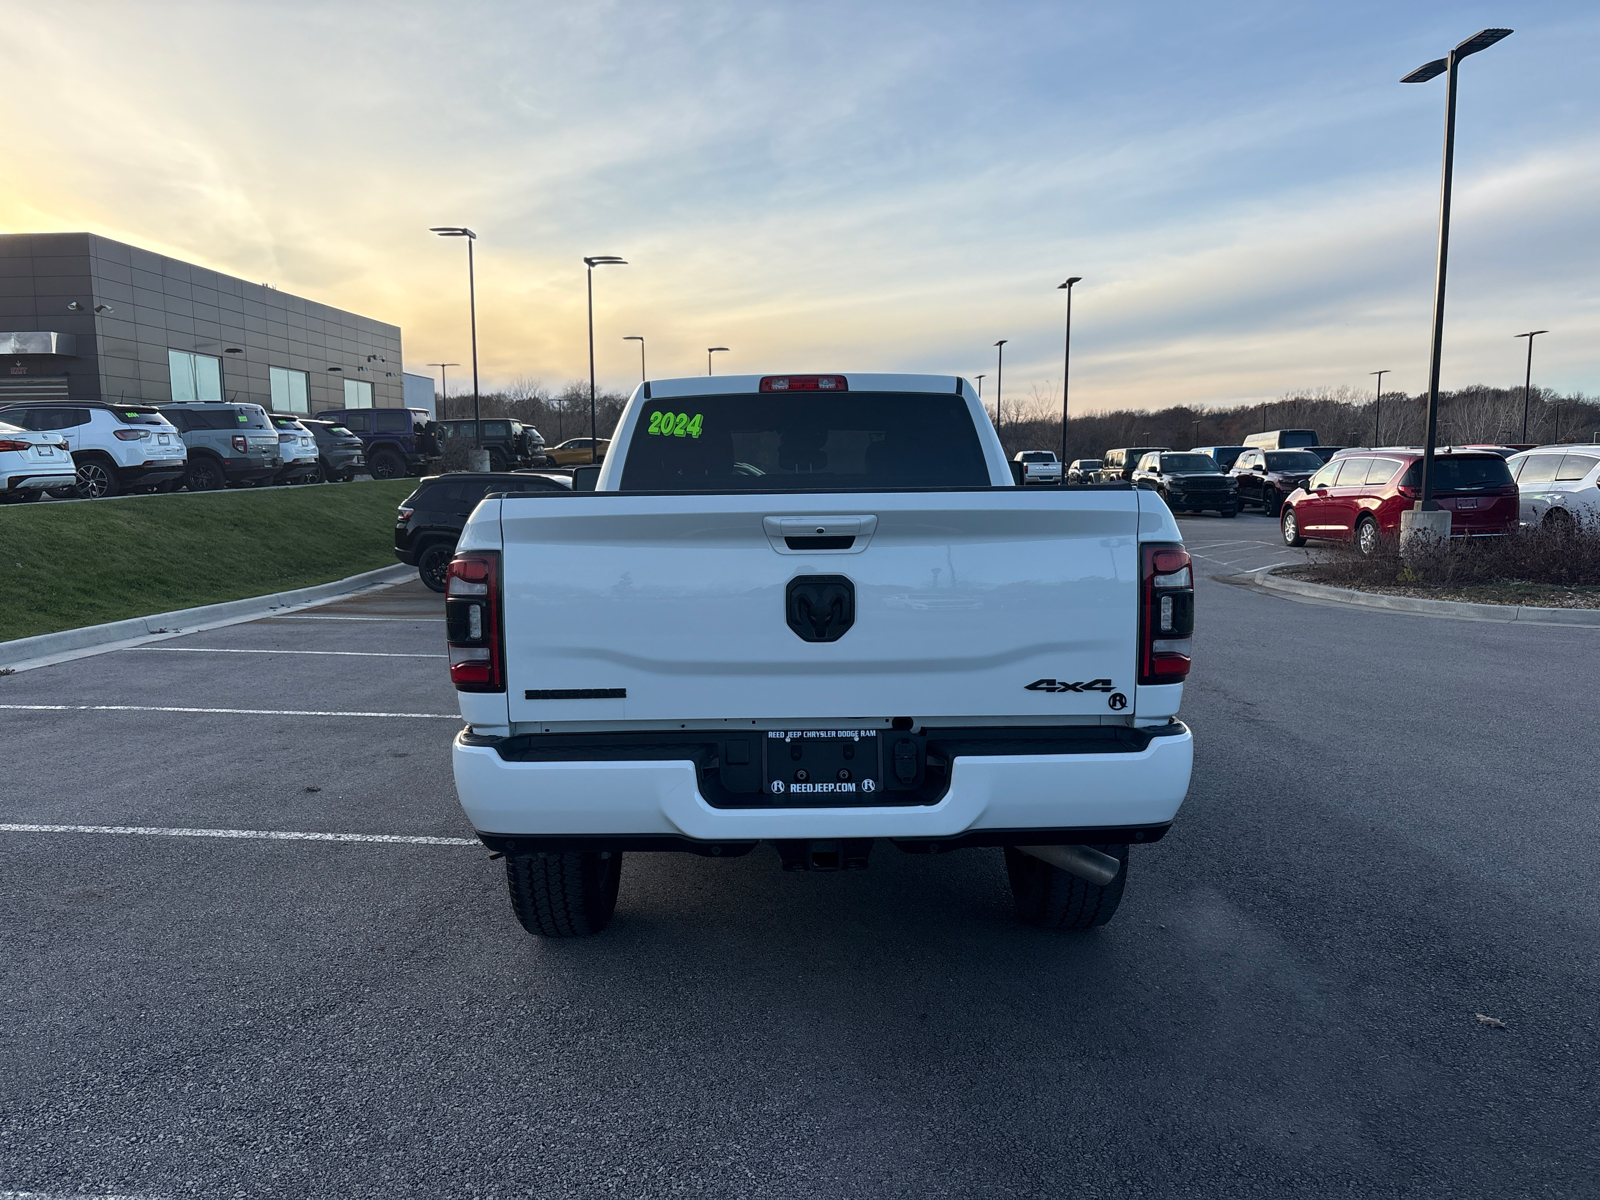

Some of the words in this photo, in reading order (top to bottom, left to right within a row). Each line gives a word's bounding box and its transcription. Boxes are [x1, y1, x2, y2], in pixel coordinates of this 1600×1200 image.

[648, 410, 704, 438] 2024
[1023, 678, 1117, 693] 4x4
[803, 730, 836, 738] CHRYSLER
[860, 729, 876, 737] RAM
[790, 782, 856, 793] REEDJEEP.COM
